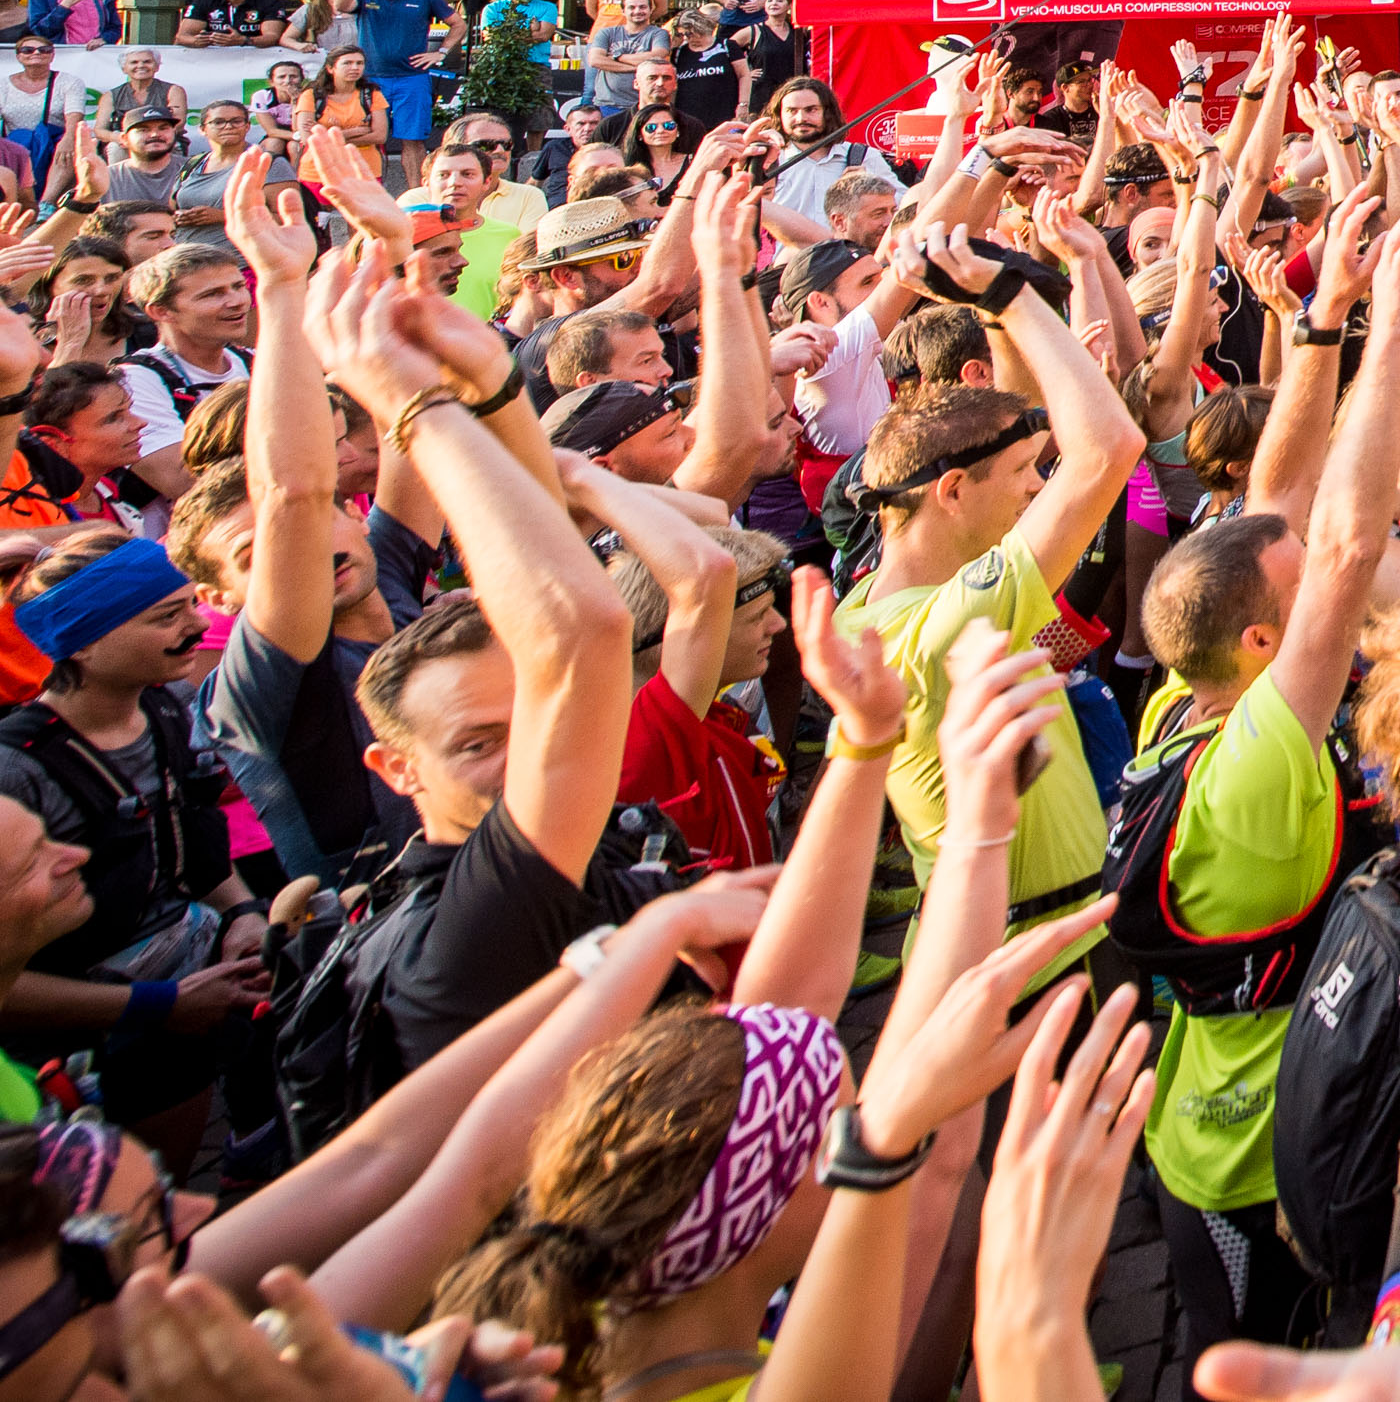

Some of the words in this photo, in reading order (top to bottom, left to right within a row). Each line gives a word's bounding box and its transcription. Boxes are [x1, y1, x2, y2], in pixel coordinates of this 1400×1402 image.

[1010, 3, 1123, 16] VEINO-MUSCULAR
[1125, 1, 1214, 13] COMPRESSION
[1215, 0, 1291, 12] TECHNOLOGY
